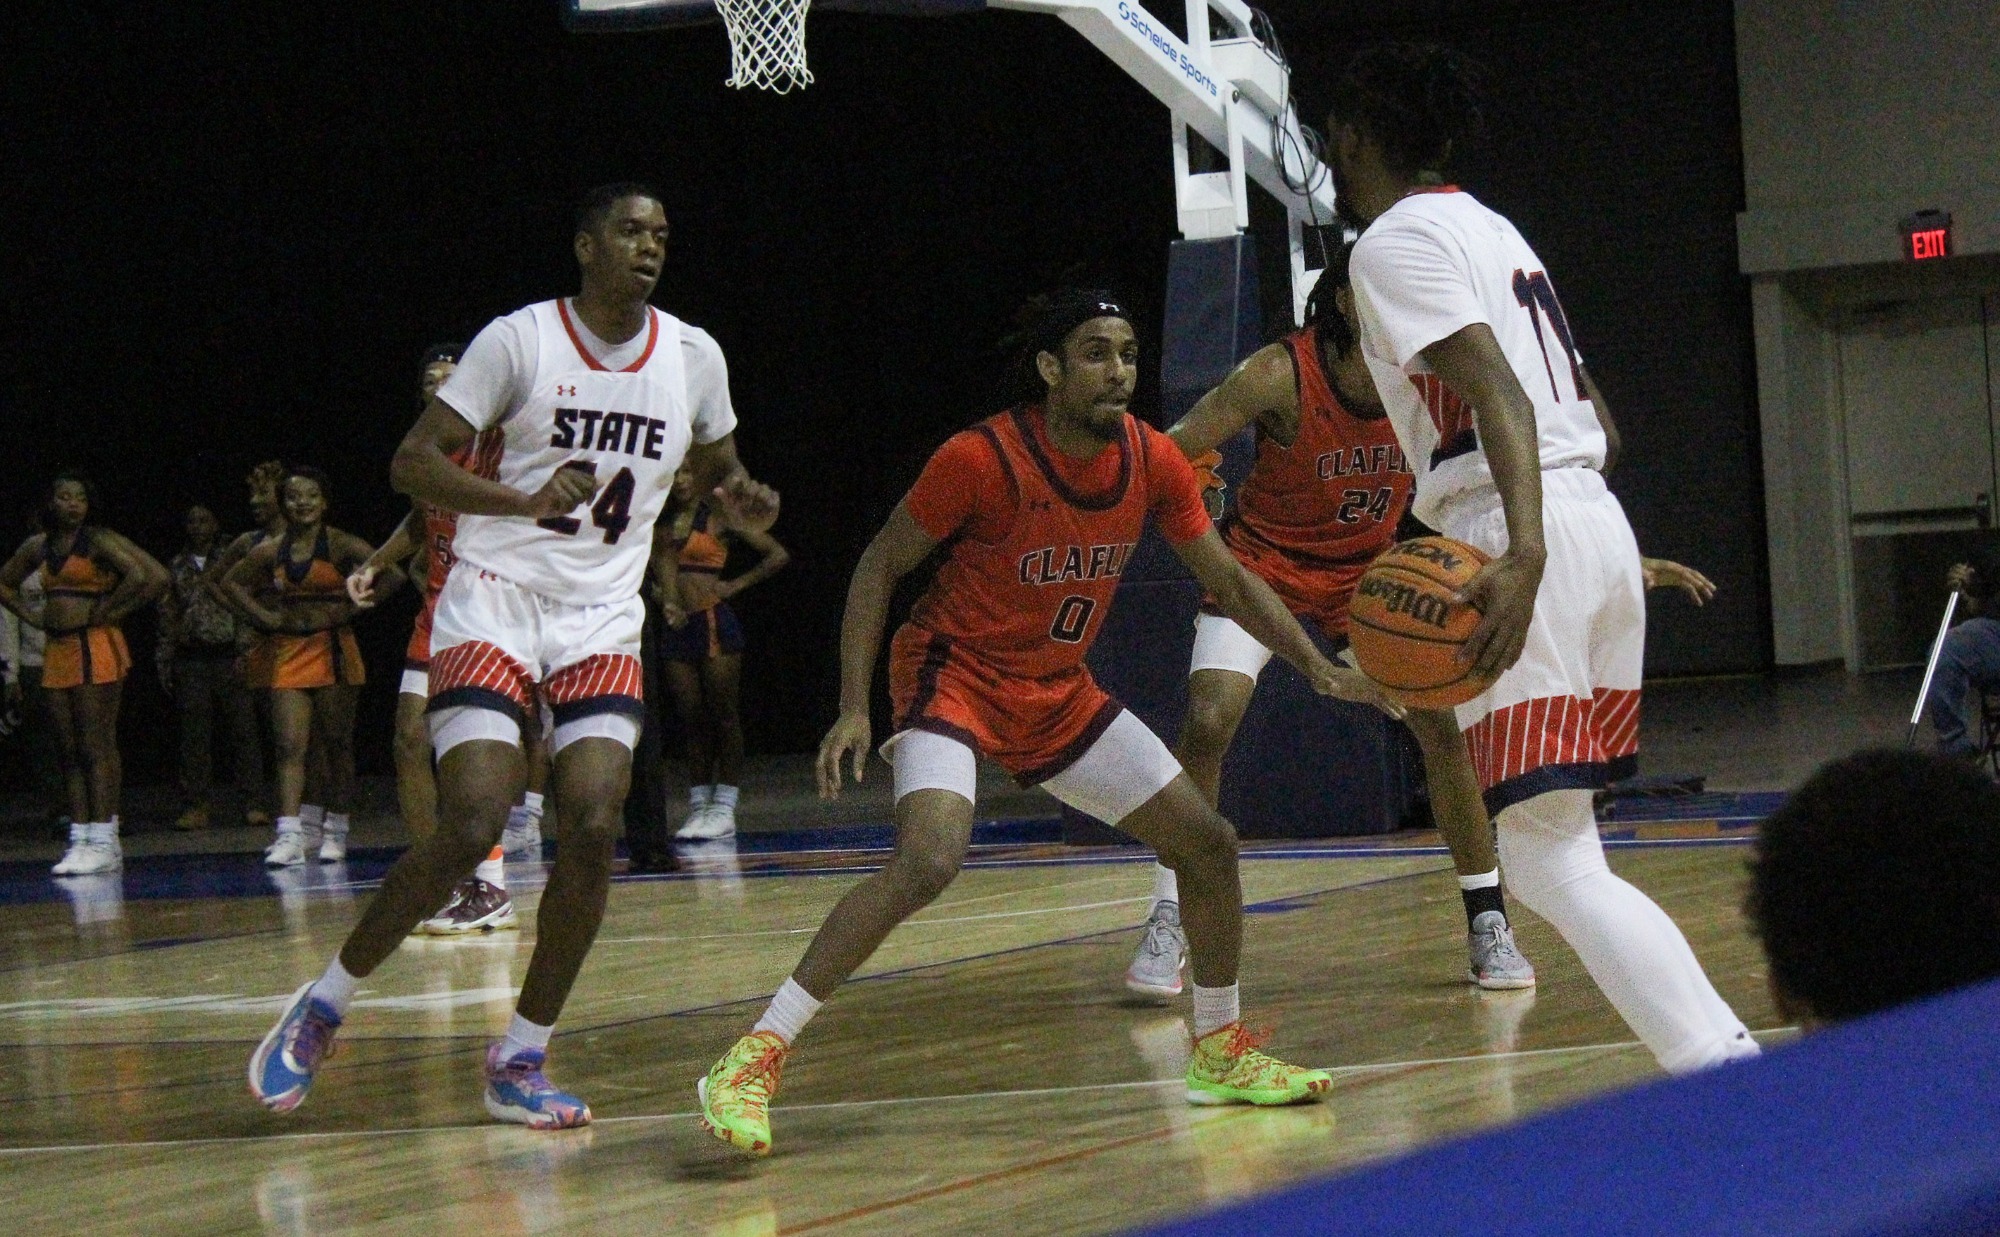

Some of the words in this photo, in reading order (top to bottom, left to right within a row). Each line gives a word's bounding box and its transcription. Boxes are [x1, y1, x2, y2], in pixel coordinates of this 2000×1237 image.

[1130, 11, 1178, 62] Schelde
[1180, 54, 1217, 97] Sports
[1911, 229, 1946, 259] EXIT
[549, 407, 667, 461] STATE
[1336, 486, 1394, 525] 24
[1050, 594, 1097, 644] 0
